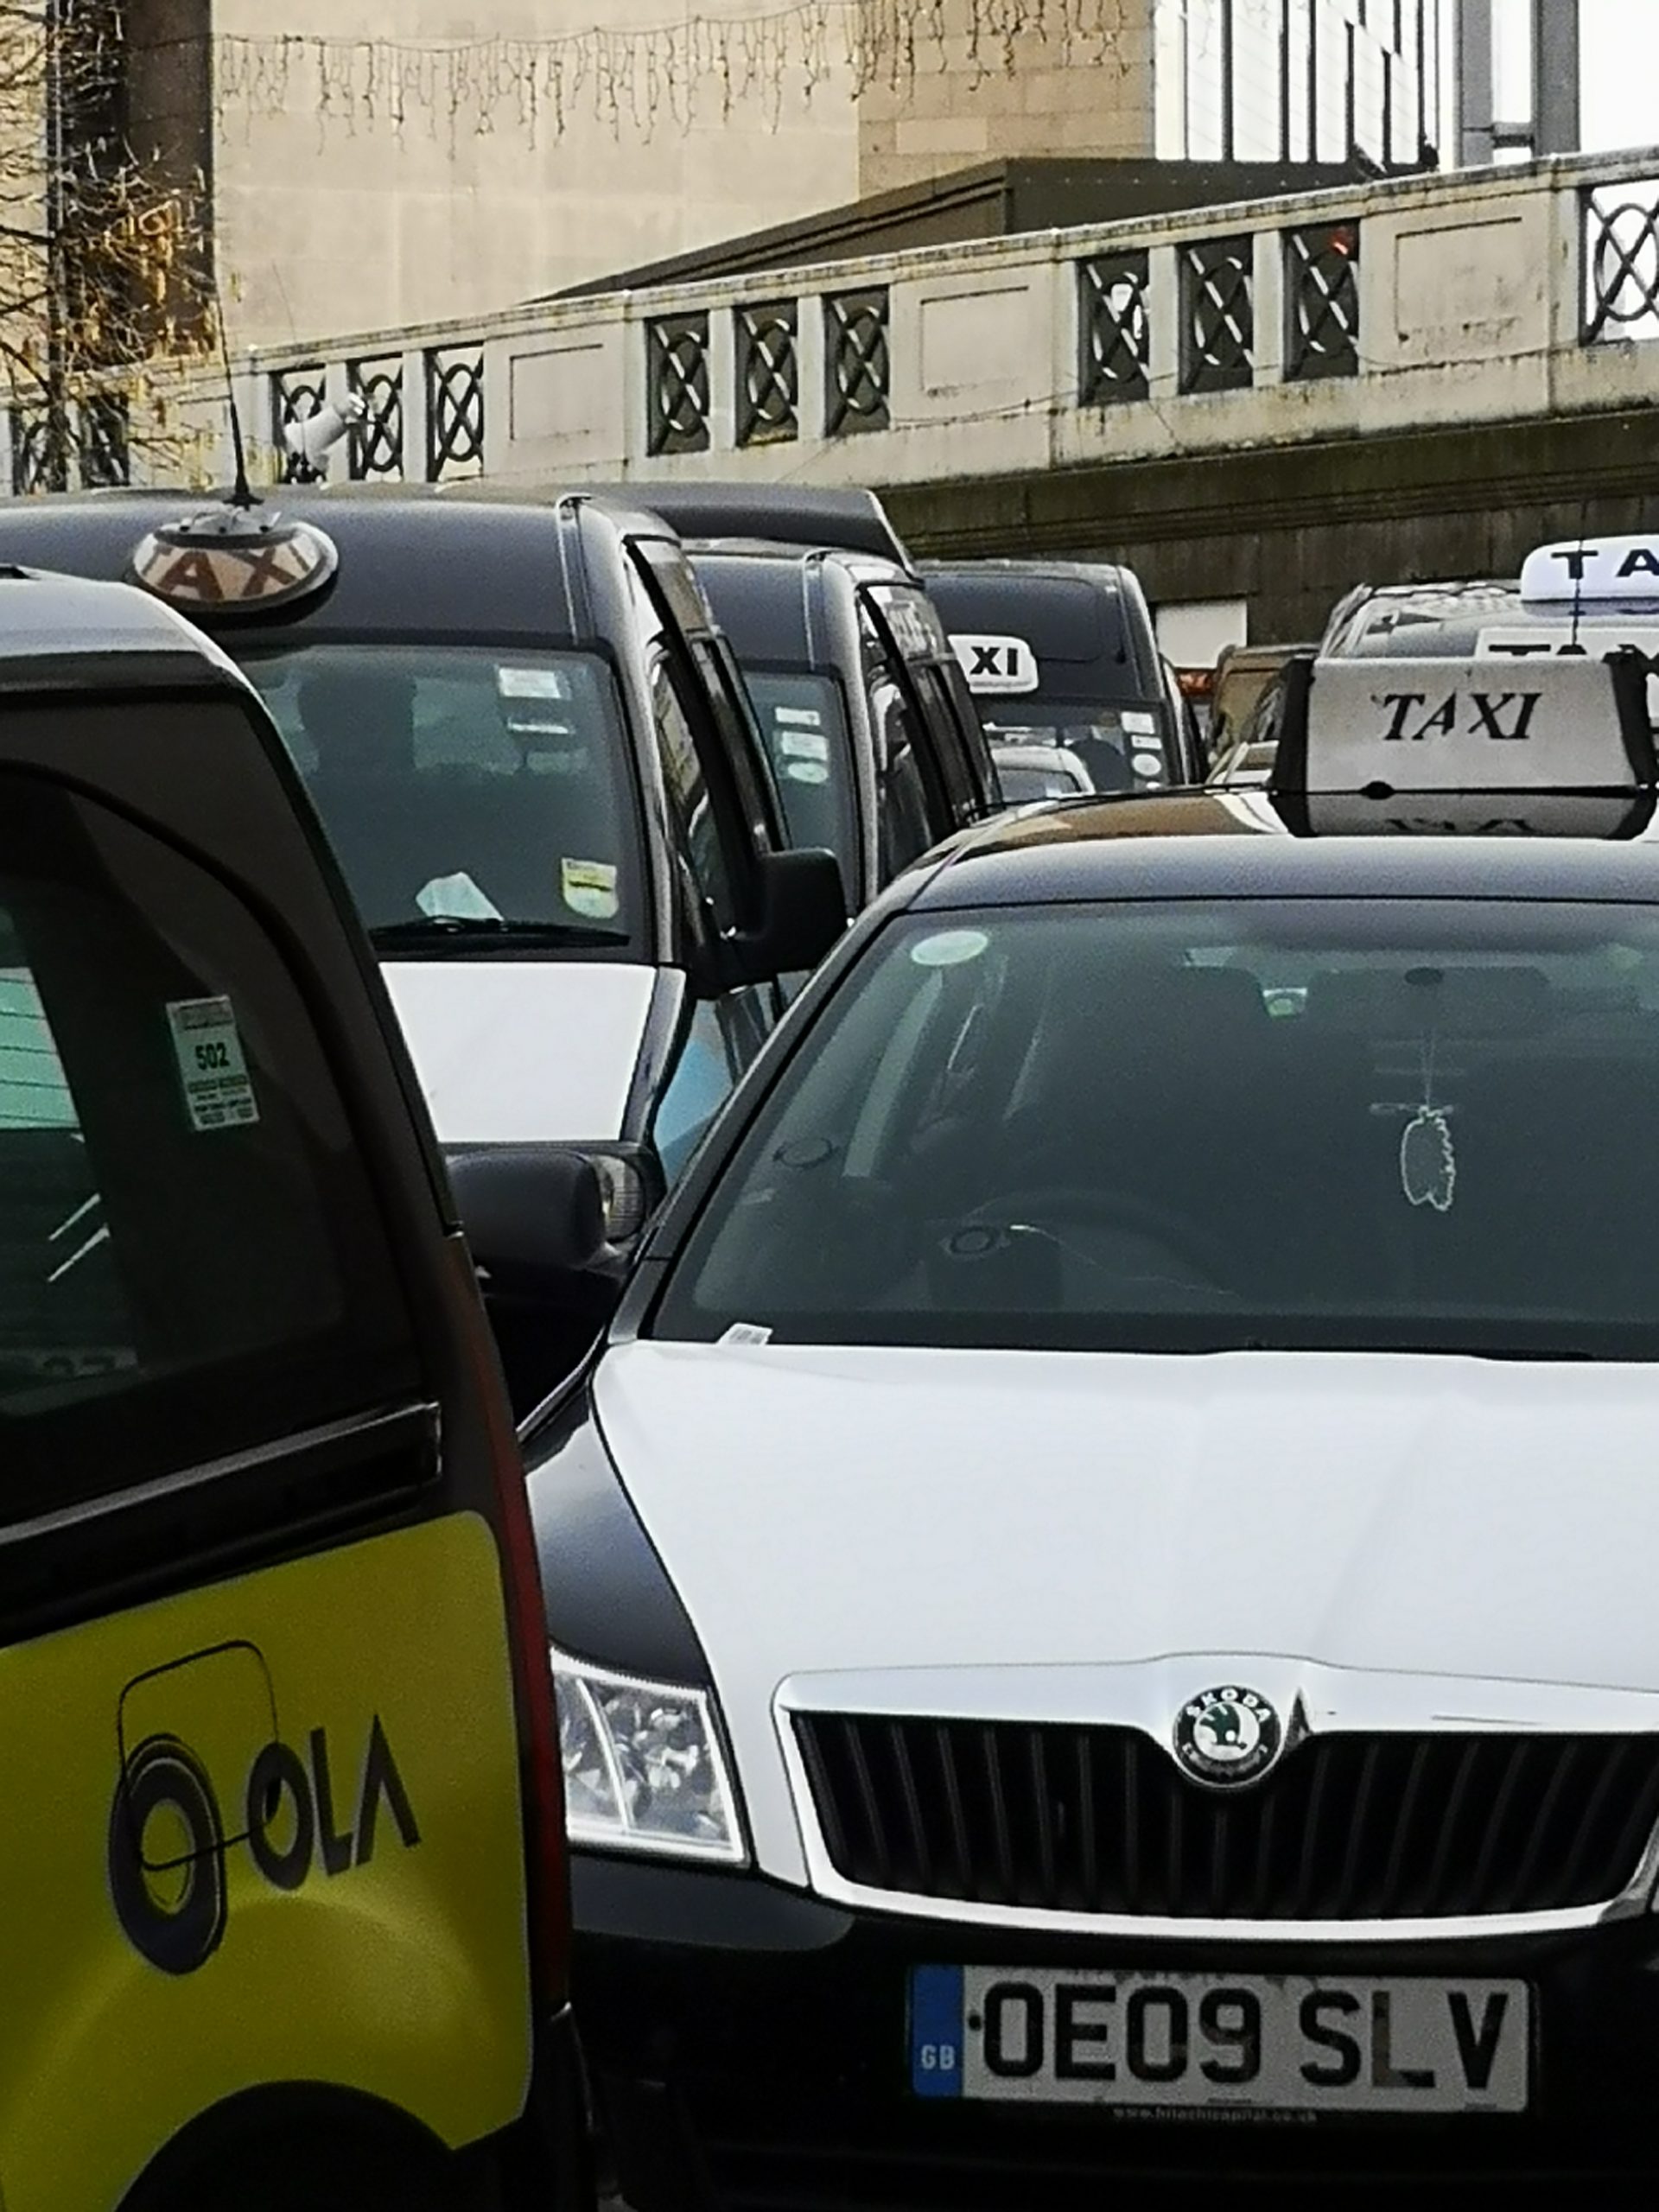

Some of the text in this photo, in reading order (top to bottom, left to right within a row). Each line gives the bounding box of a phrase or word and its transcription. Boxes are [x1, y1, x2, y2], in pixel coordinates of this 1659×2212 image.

[969, 646, 1019, 677] XI
[1382, 690, 1542, 741] TAXI
[195, 1042, 230, 1071] 502
[983, 1982, 1509, 2091] OE09 SLV
[920, 2044, 955, 2070] GB
